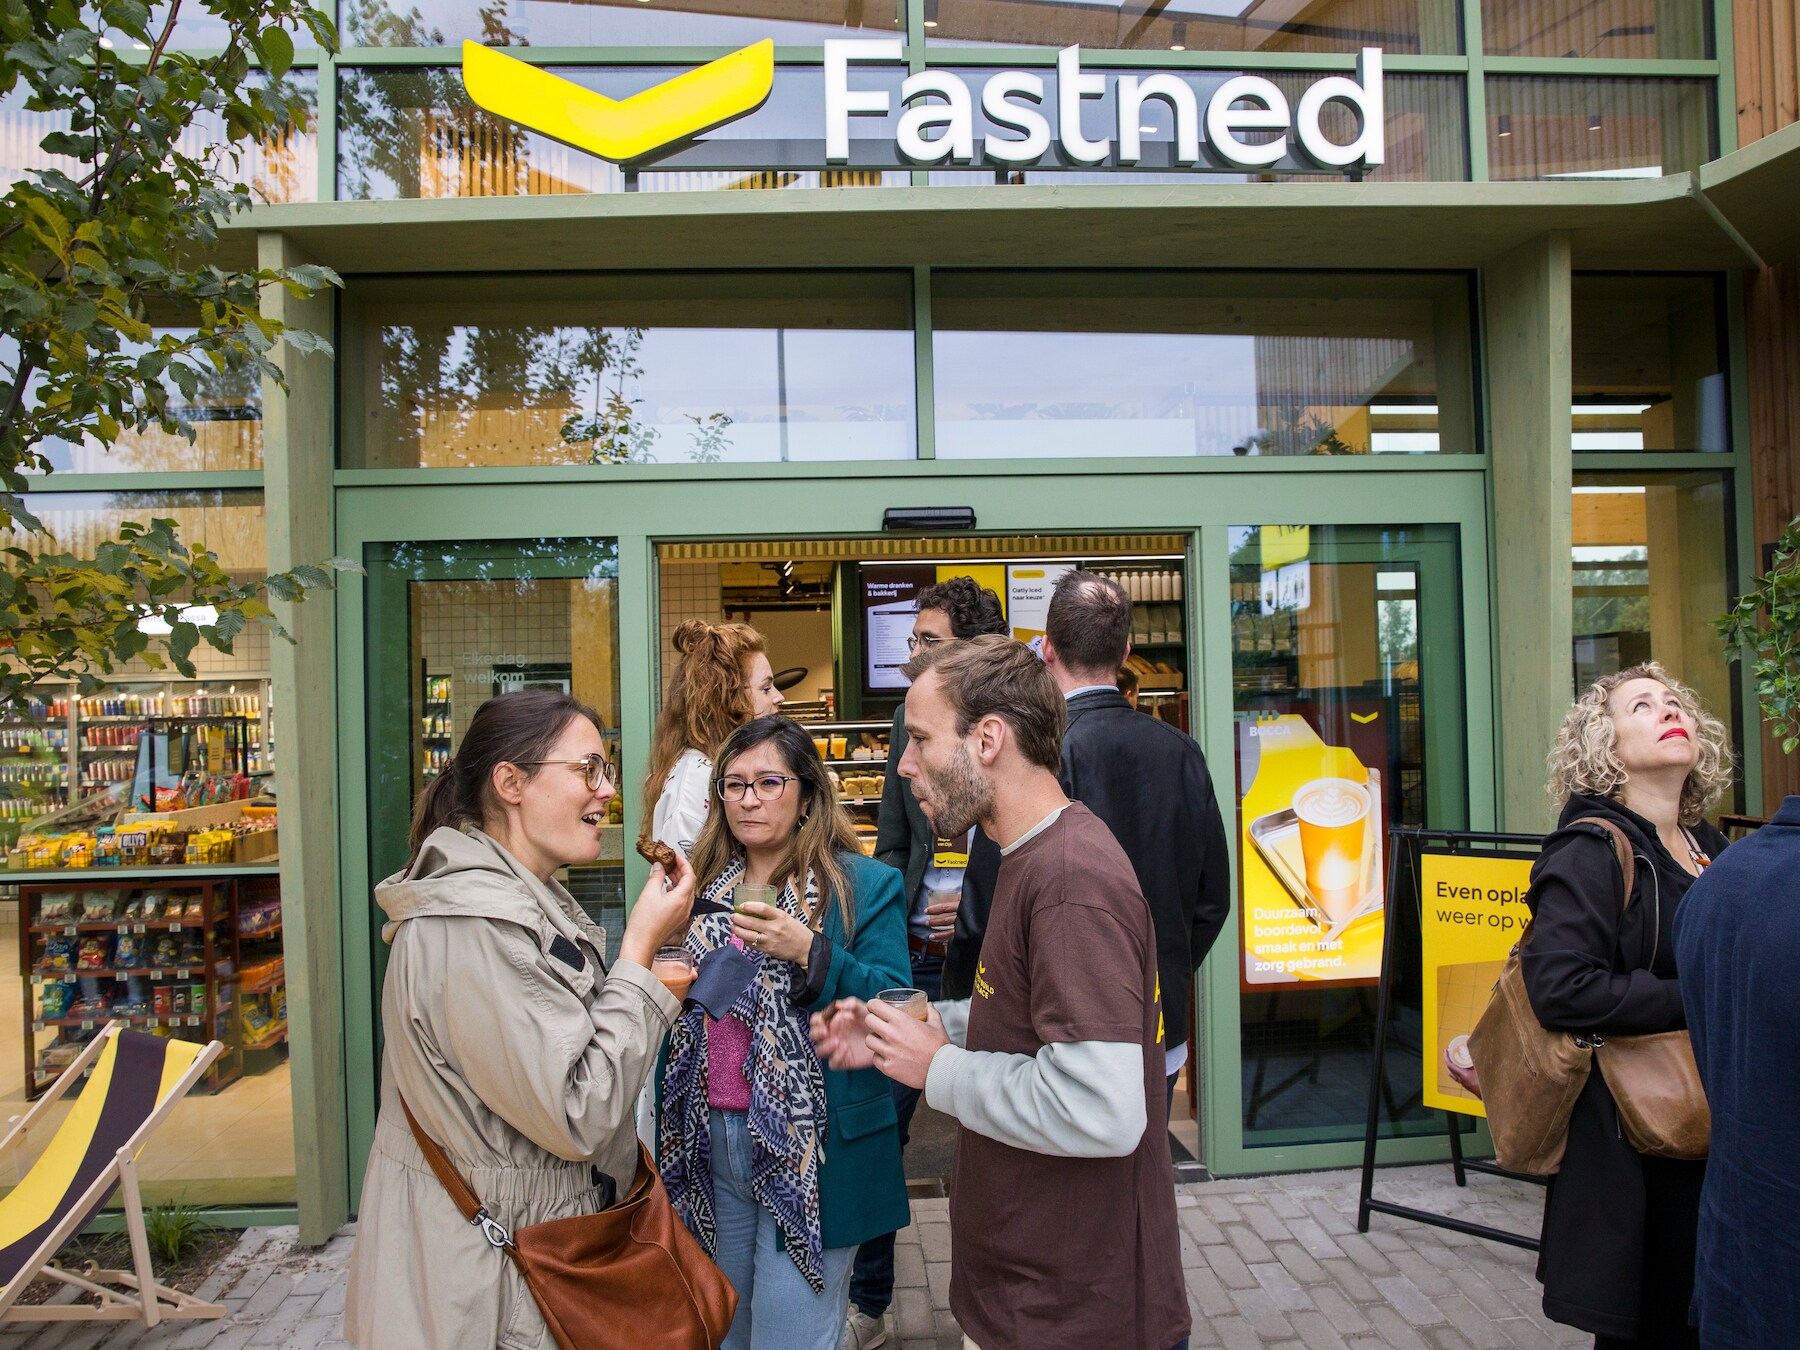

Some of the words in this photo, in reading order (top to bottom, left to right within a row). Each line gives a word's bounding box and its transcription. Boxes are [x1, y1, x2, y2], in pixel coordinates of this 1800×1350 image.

[823, 39, 1386, 168] Fastned
[873, 590, 898, 598] bakkerij
[462, 652, 493, 666] Elke
[496, 651, 526, 668] dag
[463, 669, 525, 684] welkom
[1249, 725, 1292, 737] BOCCA
[1437, 881, 1483, 901] Even
[1253, 906, 1321, 921] Duurzaam,
[1436, 909, 1484, 926] weer
[1488, 914, 1514, 932] op
[1253, 922, 1322, 938] boordevol
[1254, 941, 1297, 955] smaak
[1298, 942, 1315, 952] en
[1316, 939, 1344, 951] met
[1254, 959, 1285, 974] zorg
[1286, 954, 1346, 973] gebrand.
